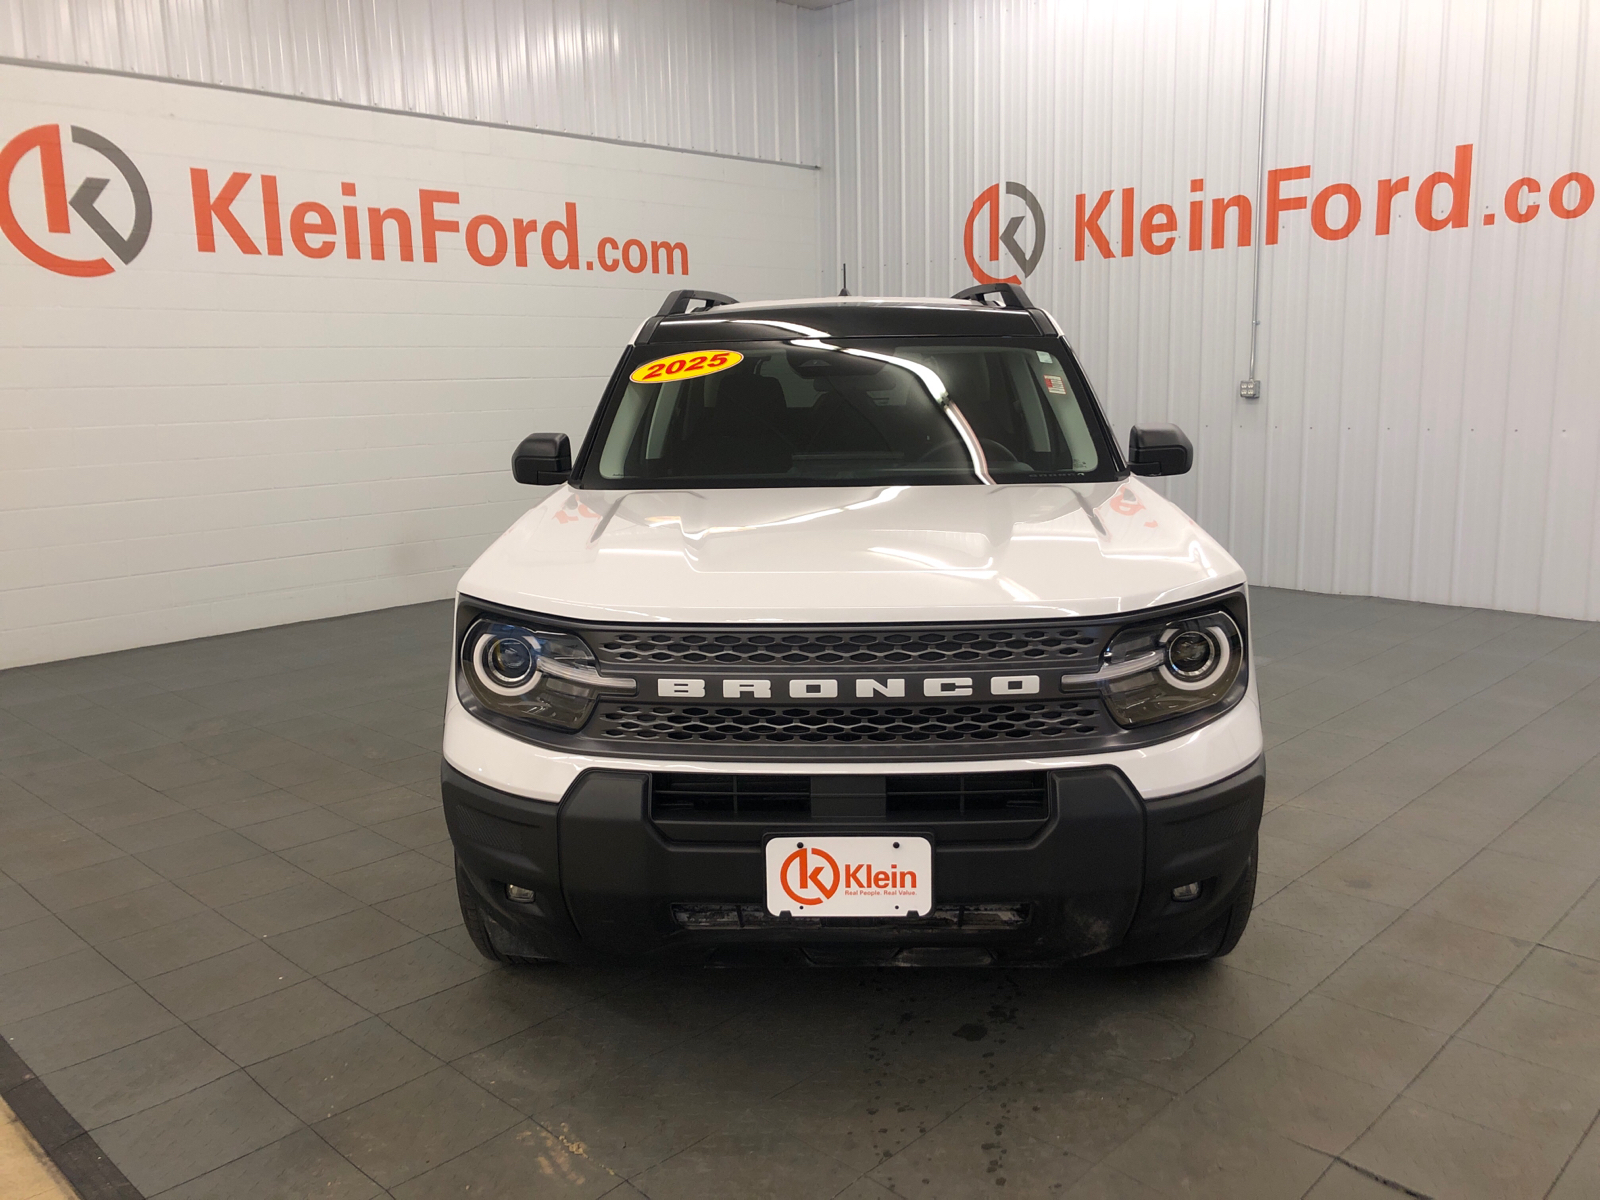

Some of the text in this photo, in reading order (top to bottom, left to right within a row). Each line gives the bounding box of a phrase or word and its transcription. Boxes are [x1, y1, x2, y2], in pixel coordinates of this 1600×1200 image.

[190, 167, 689, 276] KleinFord.com
[642, 352, 731, 380] 2025
[657, 675, 1040, 698] BRONCO
[844, 863, 918, 889] Klein
[859, 889, 882, 897] People.
